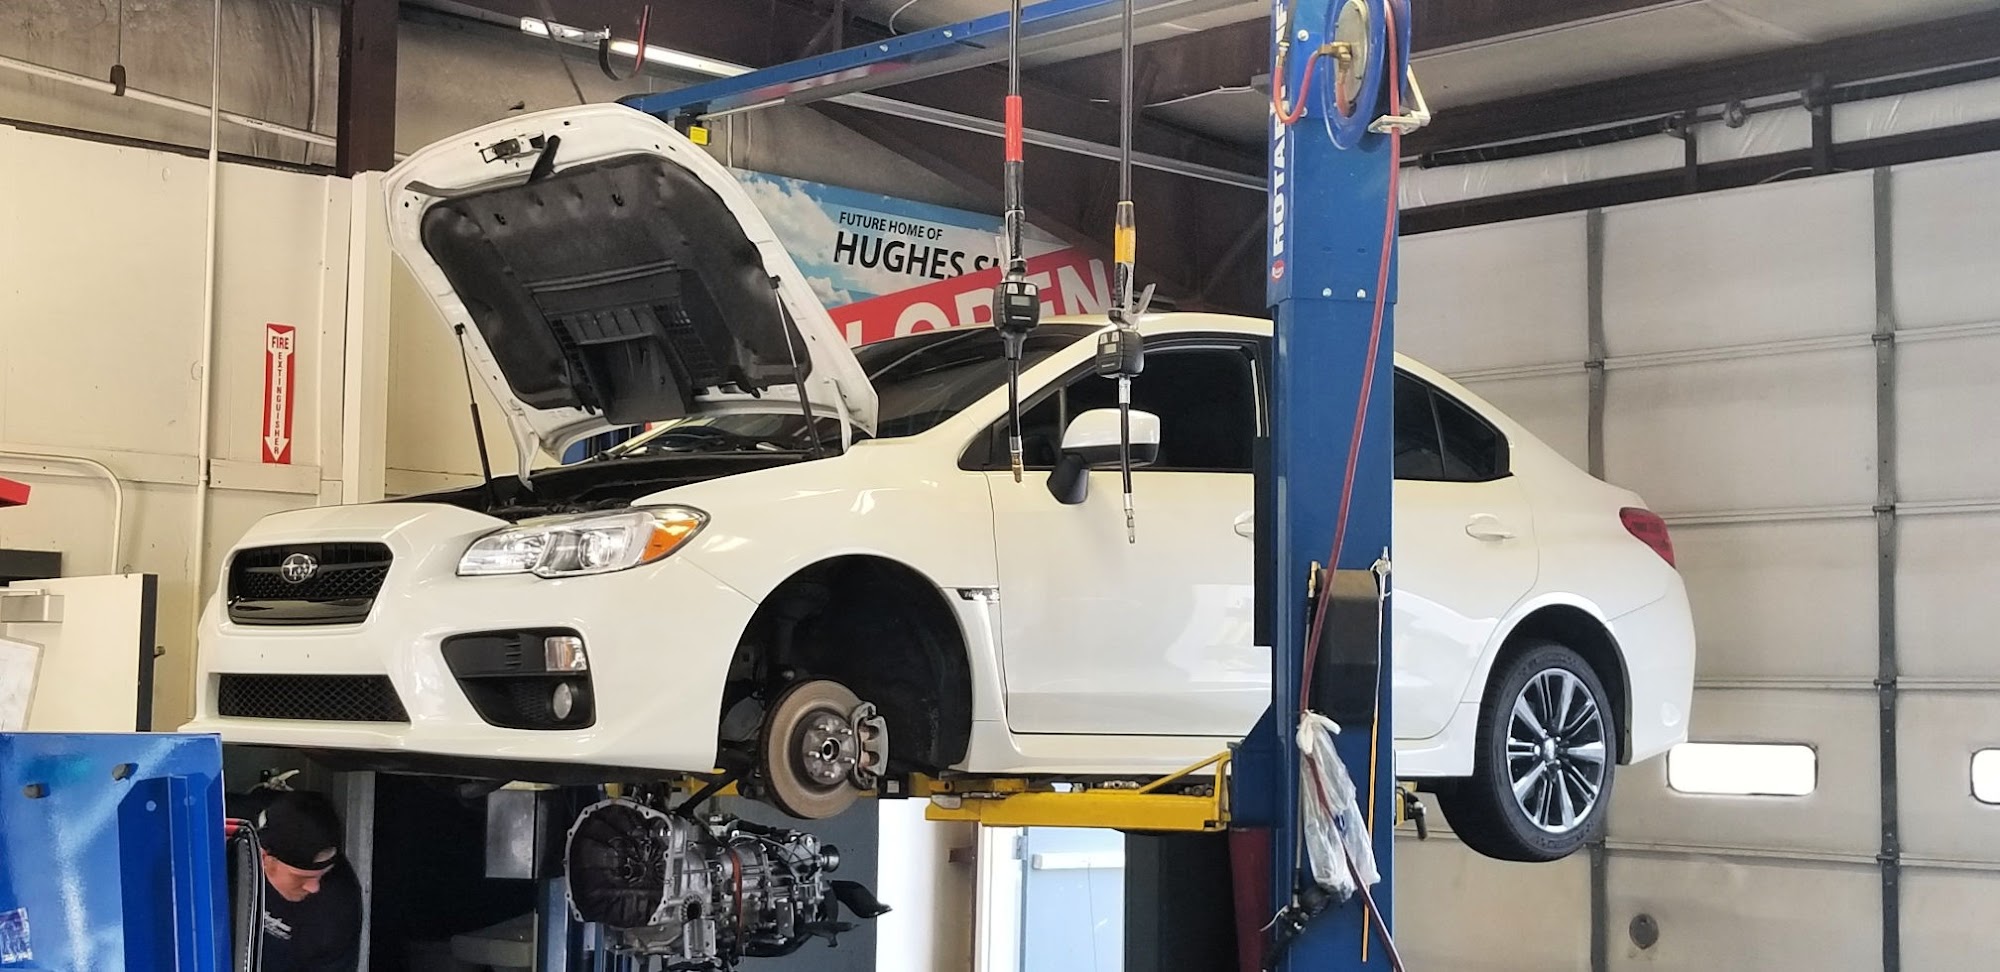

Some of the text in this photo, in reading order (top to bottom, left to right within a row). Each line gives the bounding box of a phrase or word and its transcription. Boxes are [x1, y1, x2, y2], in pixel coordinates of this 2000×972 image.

[839, 211, 943, 240] FUTURE HOME OF
[833, 230, 965, 279] HUGHES
[271, 336, 289, 350] FIRE
[274, 351, 283, 455] EXTINGUISHER
